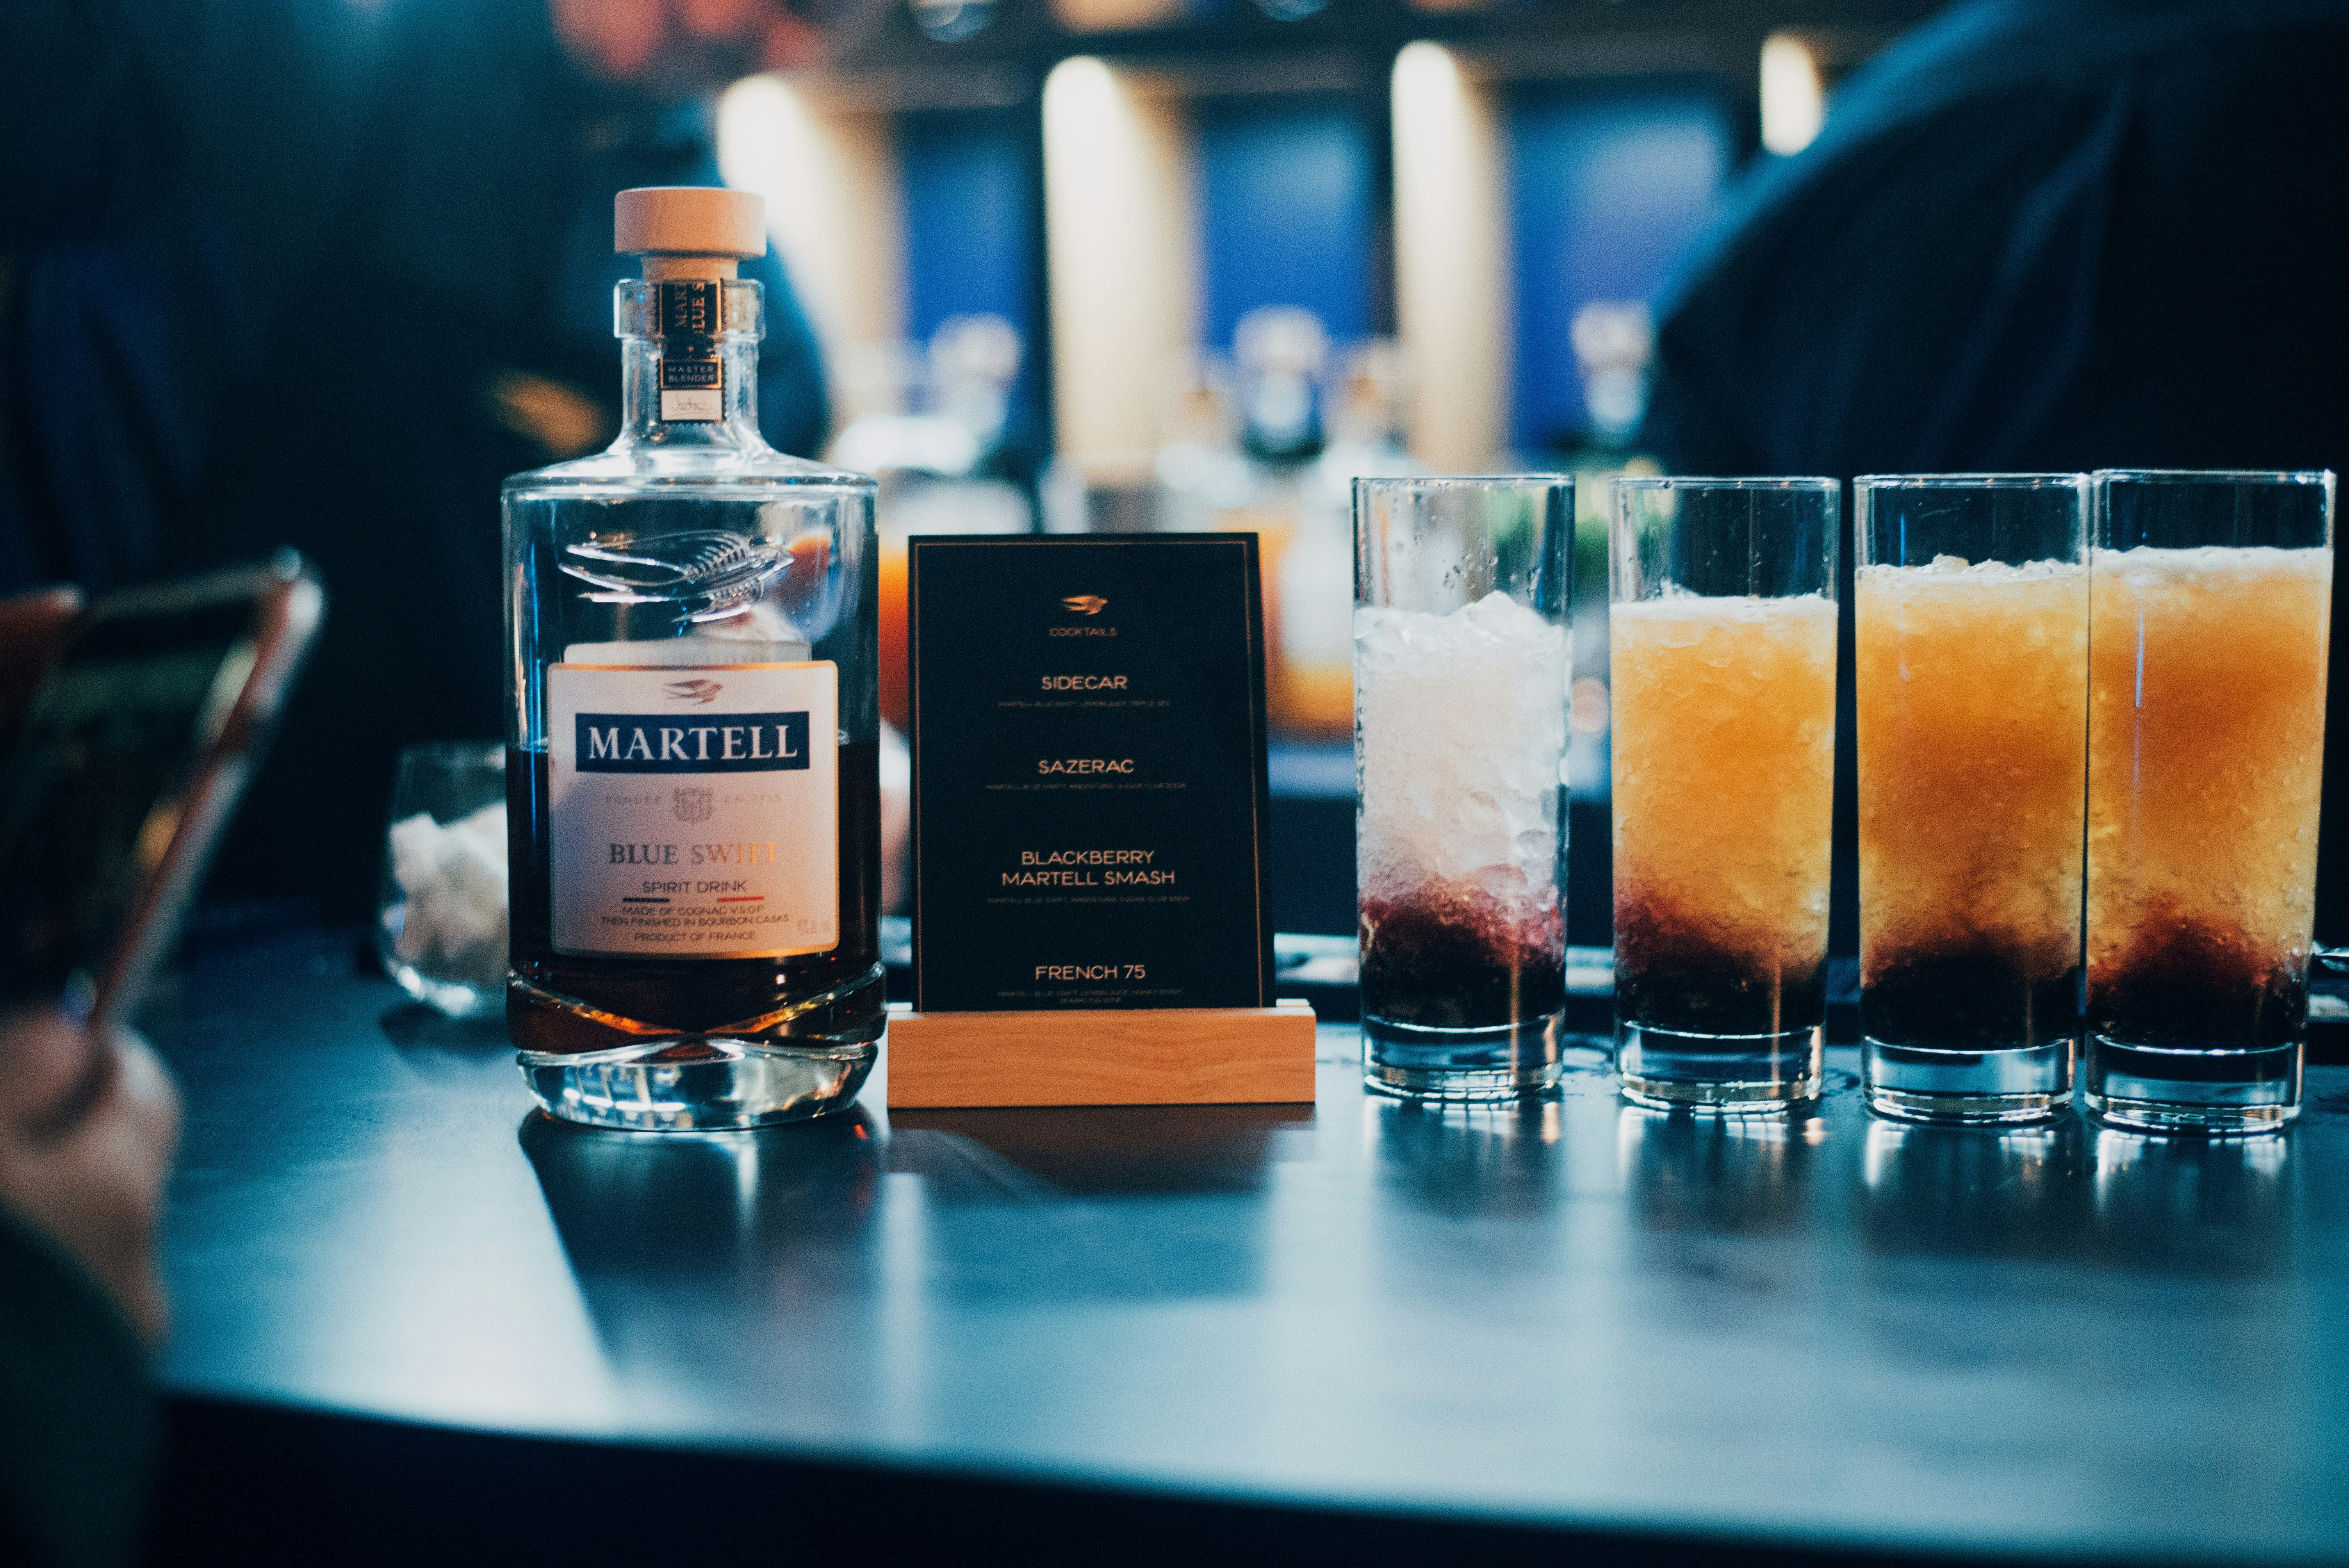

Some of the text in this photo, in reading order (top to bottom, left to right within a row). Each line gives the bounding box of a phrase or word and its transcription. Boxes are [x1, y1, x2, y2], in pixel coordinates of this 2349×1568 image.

[668, 374, 714, 383] BLENDER
[1050, 628, 1116, 636] COCKTAILS
[1041, 675, 1128, 690] SIDECAR
[589, 725, 798, 760] MARTELL
[1039, 759, 1134, 774] SAZERAC
[610, 841, 779, 865] BLUE SWIFT
[1021, 850, 1154, 865] BLACKBERRY
[1002, 871, 1175, 886] MARTELL SMASH
[643, 880, 747, 893] SPIRIT DRINK
[623, 907, 655, 916] MADE
[660, 907, 675, 915] OF
[678, 906, 727, 915] COGNAC
[602, 914, 790, 927] THEN FINISHED IN BOURBON CASKS
[634, 931, 756, 941] PRODUCT OF FRANCE
[1035, 964, 1146, 980] FRENCH 75
